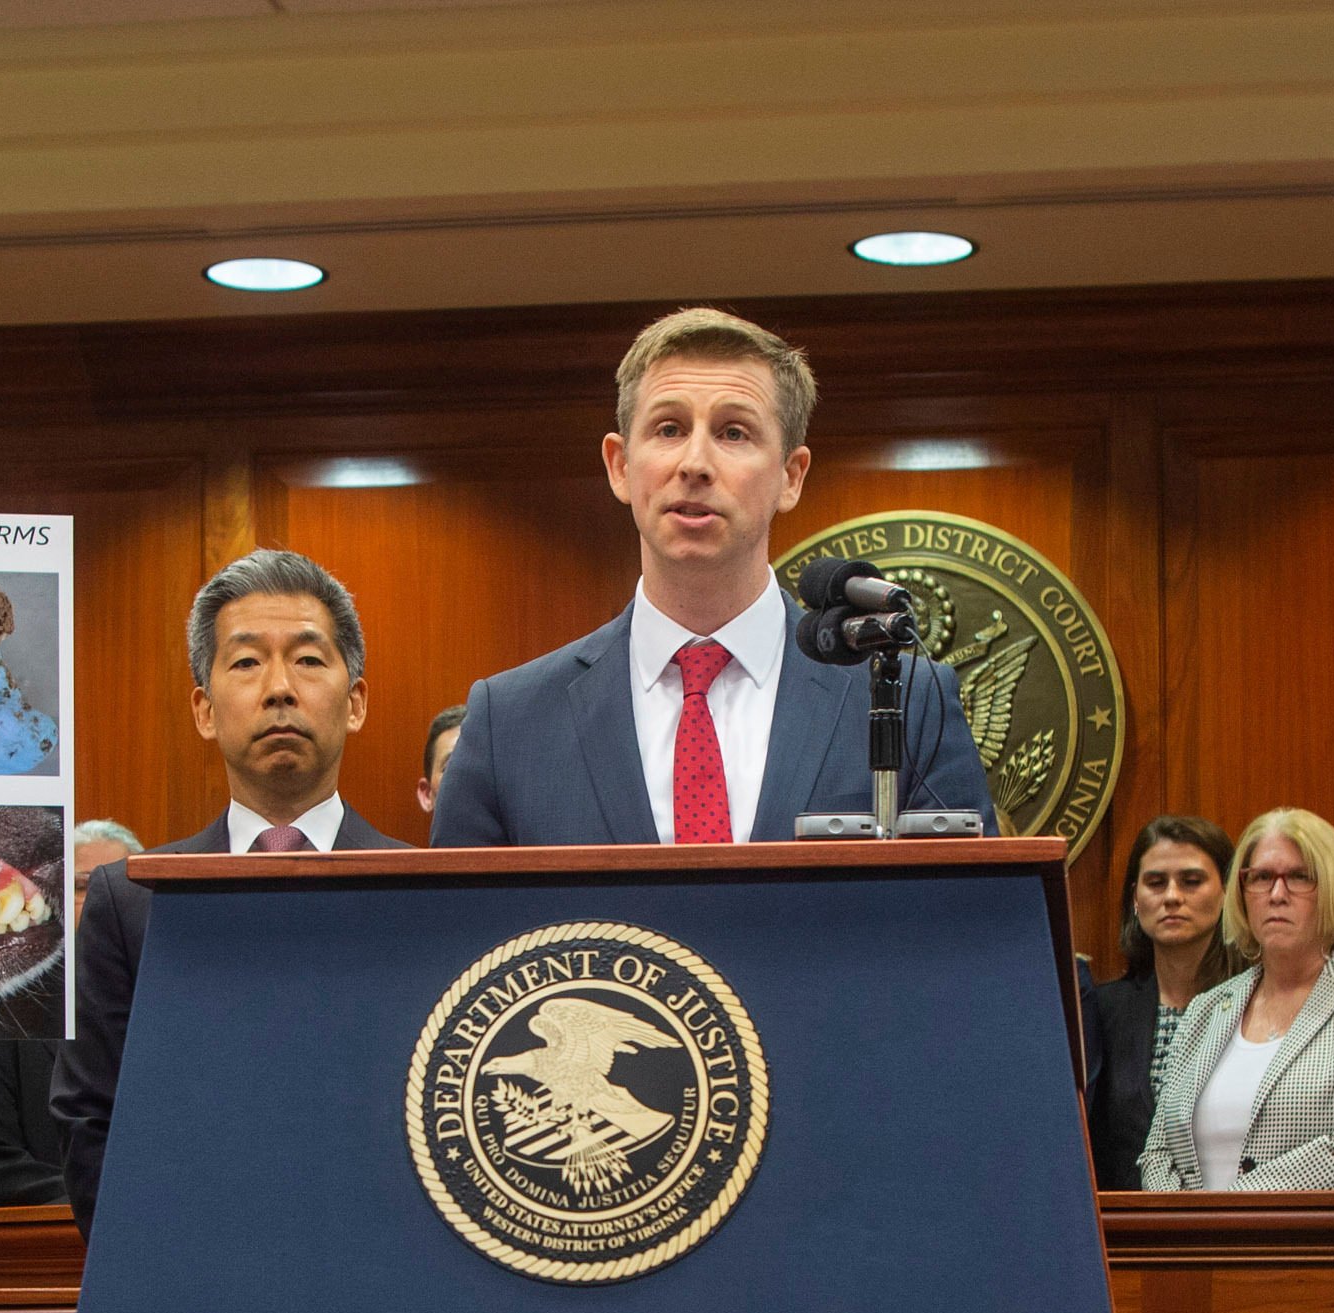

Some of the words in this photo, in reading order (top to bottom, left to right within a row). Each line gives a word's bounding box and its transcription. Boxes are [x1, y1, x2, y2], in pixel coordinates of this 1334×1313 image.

[903, 524, 1039, 586] DISTRICT
[1040, 587, 1105, 679] COURT
[1055, 758, 1108, 841] GINIA
[433, 950, 600, 1143] DEPARTMENT
[612, 954, 667, 991] OF
[666, 986, 740, 1145] JUSTICE
[463, 1157, 509, 1209] UNITED
[505, 1202, 561, 1235] STATES
[560, 1204, 660, 1237] ATTORNEY'S
[656, 1162, 706, 1212] OFFICE
[473, 1094, 491, 1128] QUI
[482, 1132, 506, 1166] PRO
[505, 1166, 570, 1209] DOMINA
[577, 1173, 659, 1209] JUSTITIA
[656, 1086, 697, 1174] SEQUITUR
[482, 1204, 545, 1245] WESTERN
[541, 1235, 606, 1252] DISTRICT
[607, 1234, 628, 1249] OF
[626, 1205, 689, 1243] VIRGINIA
